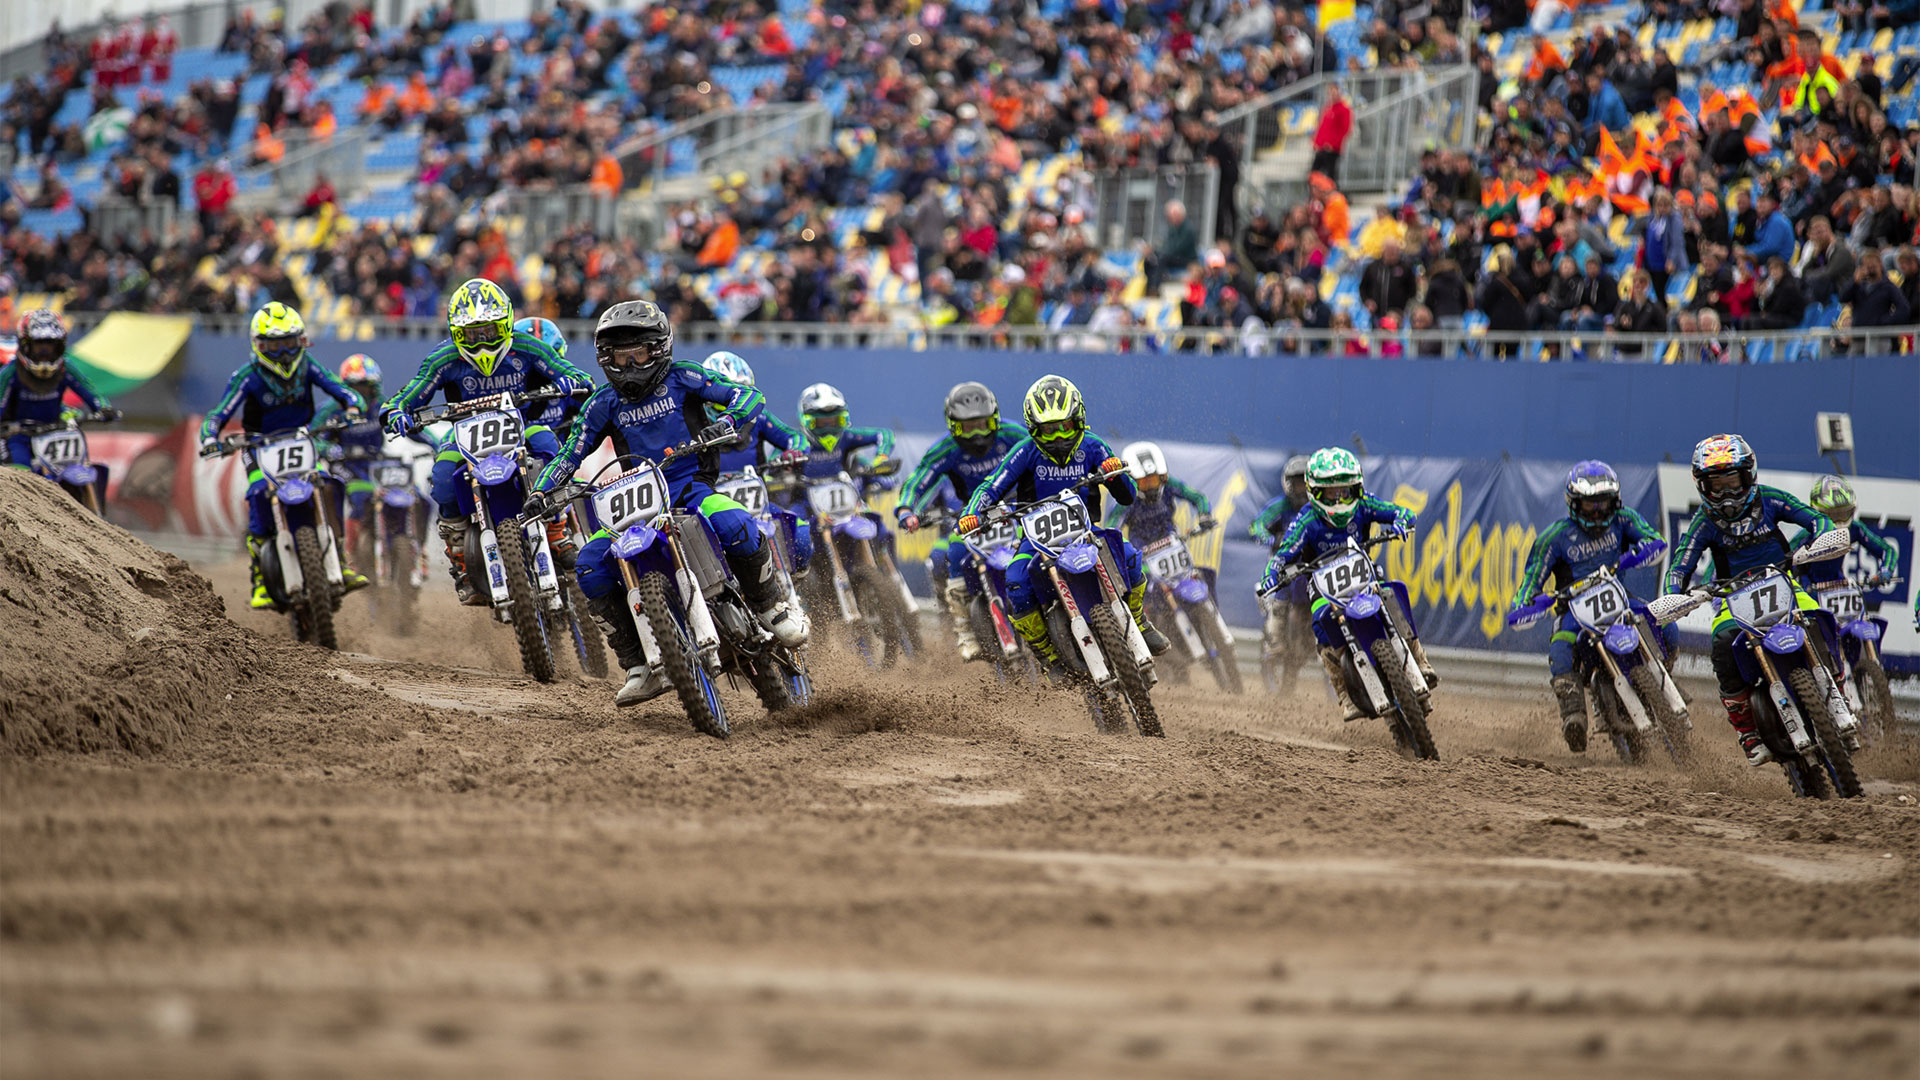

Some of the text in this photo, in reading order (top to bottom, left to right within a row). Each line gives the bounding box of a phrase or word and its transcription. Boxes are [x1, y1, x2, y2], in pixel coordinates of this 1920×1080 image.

[477, 372, 527, 390] YAMAH
[628, 396, 677, 422] YAMAHA
[468, 417, 521, 454] 192
[44, 438, 80, 460] 471
[277, 446, 304, 473] 15
[601, 467, 640, 487] RENTHA
[611, 475, 637, 490] YAMAHA
[1047, 464, 1085, 477] YAMAHA
[610, 482, 653, 525] 910
[724, 486, 762, 510] 47
[830, 489, 845, 508] 11
[1034, 503, 1085, 544] 999
[1578, 532, 1617, 554] YAMAHA
[1158, 551, 1189, 577] 916
[1386, 479, 1557, 641] Telegr
[1323, 558, 1370, 598] 194
[1585, 589, 1616, 621] 78
[1750, 583, 1780, 620] 17
[1826, 595, 1862, 615] 576
